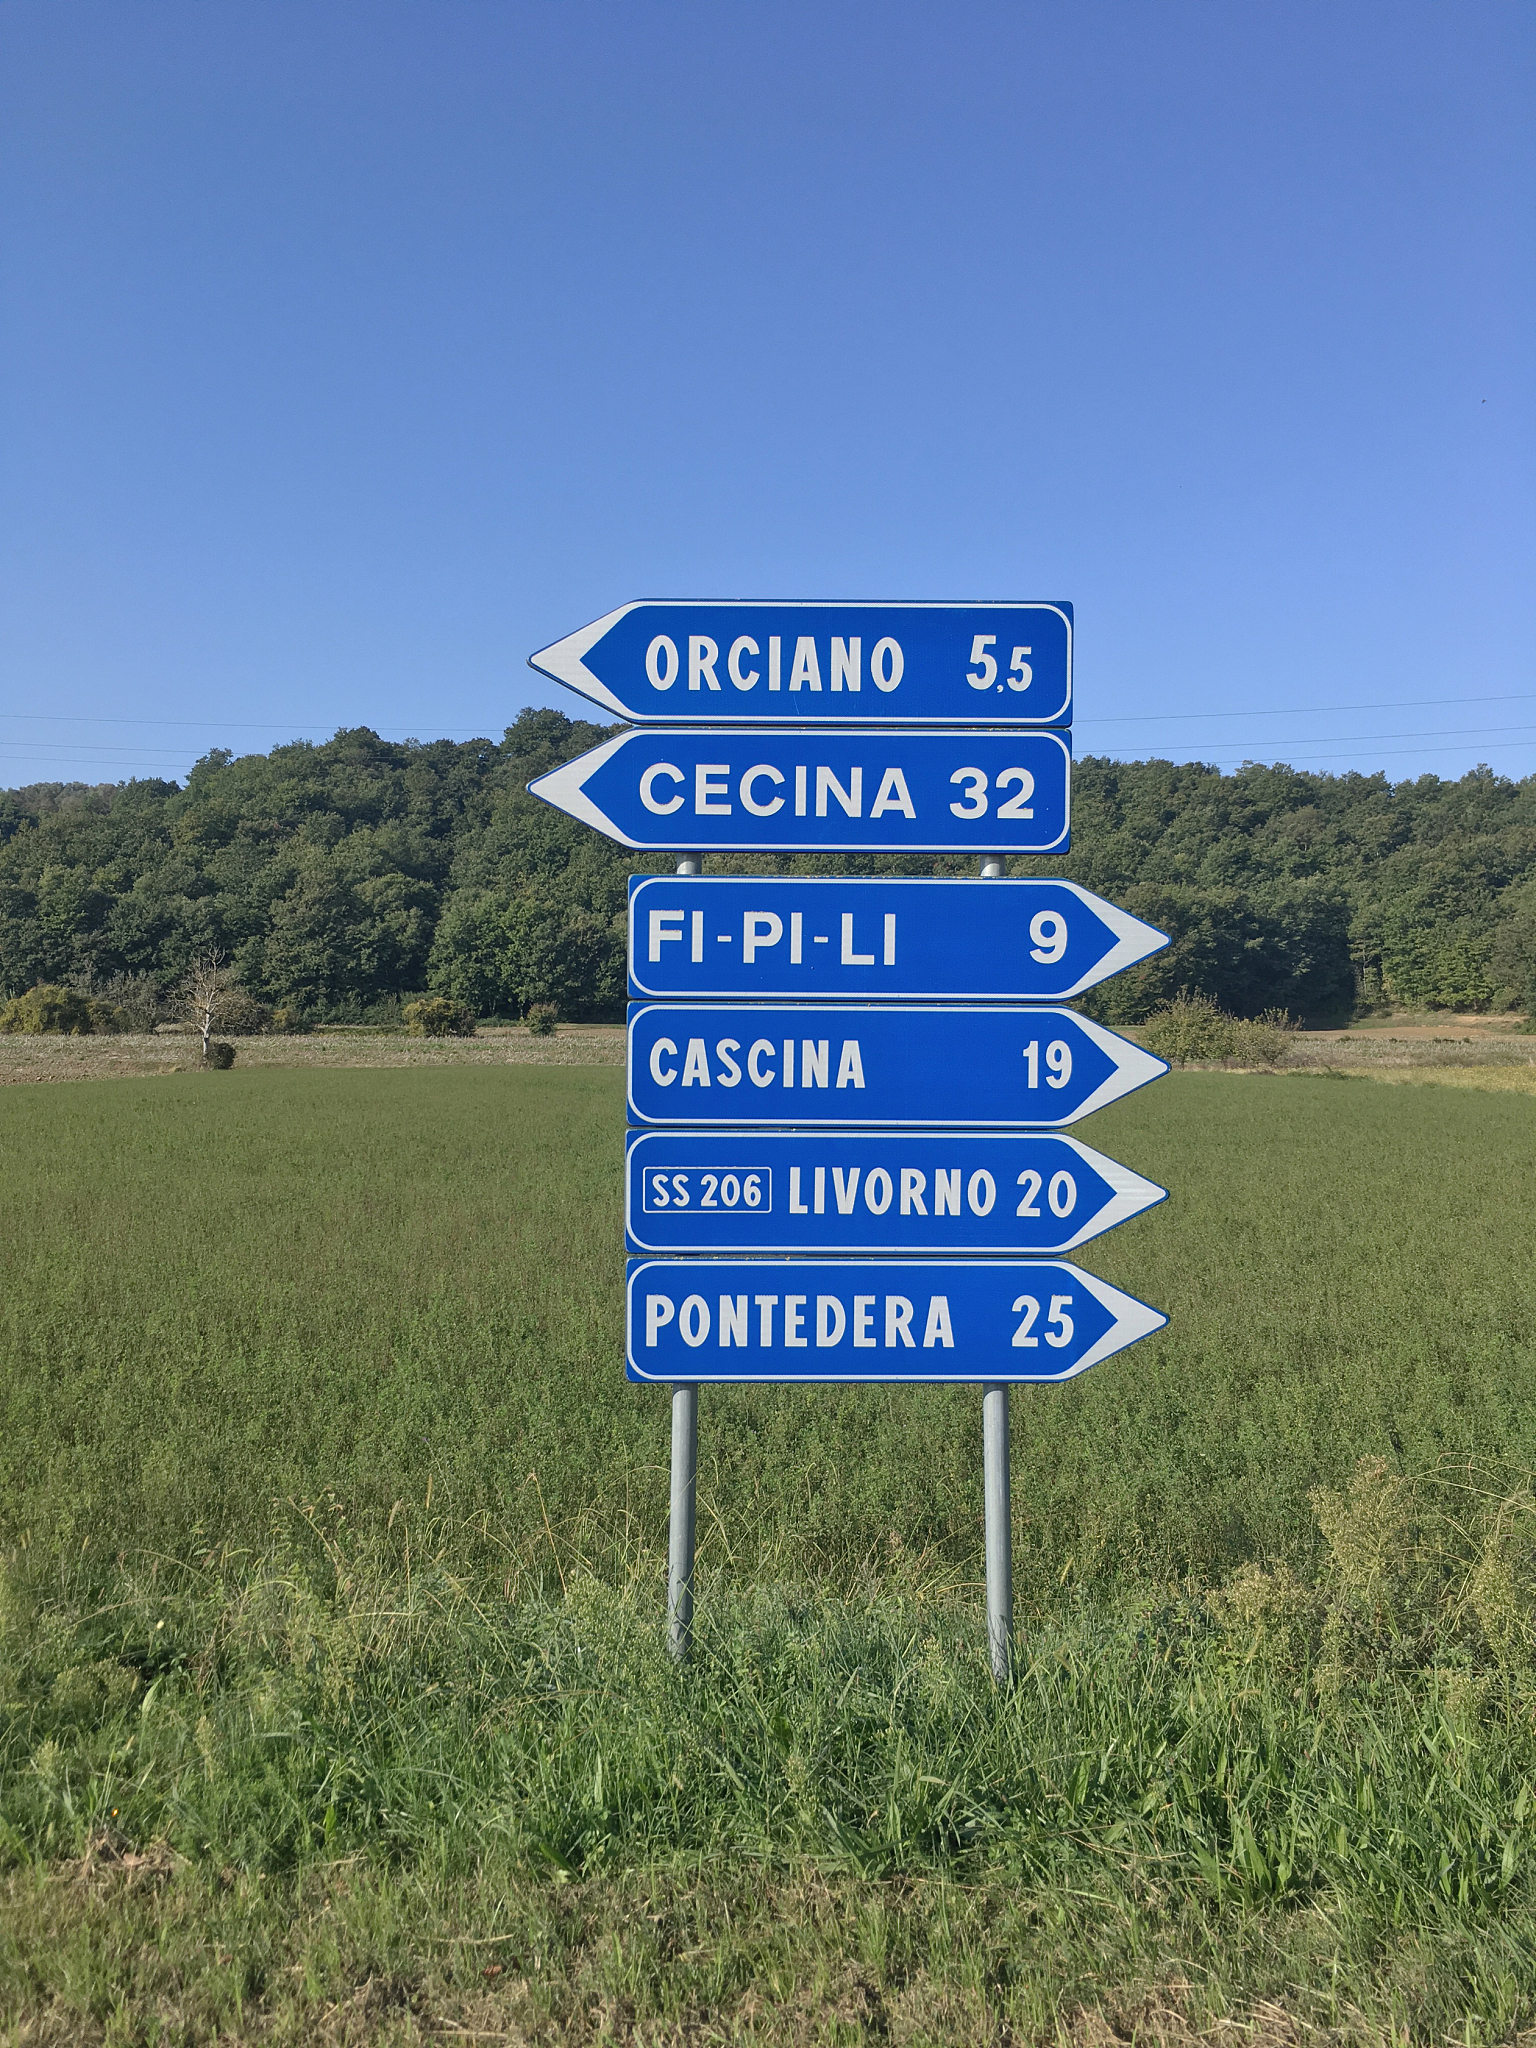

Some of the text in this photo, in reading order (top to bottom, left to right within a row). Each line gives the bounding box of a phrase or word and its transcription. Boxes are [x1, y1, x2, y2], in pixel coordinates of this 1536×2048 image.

[645, 635, 1032, 694] ORCIANO 5,5
[639, 763, 1034, 820] CECINA 32
[648, 910, 1068, 966] FI-PI-LI 9
[649, 1037, 1073, 1089] CASCINA 19
[652, 1166, 1077, 1218] SS 206 LIVORNO 20
[645, 1294, 1074, 1348] PONTEDERA 25
